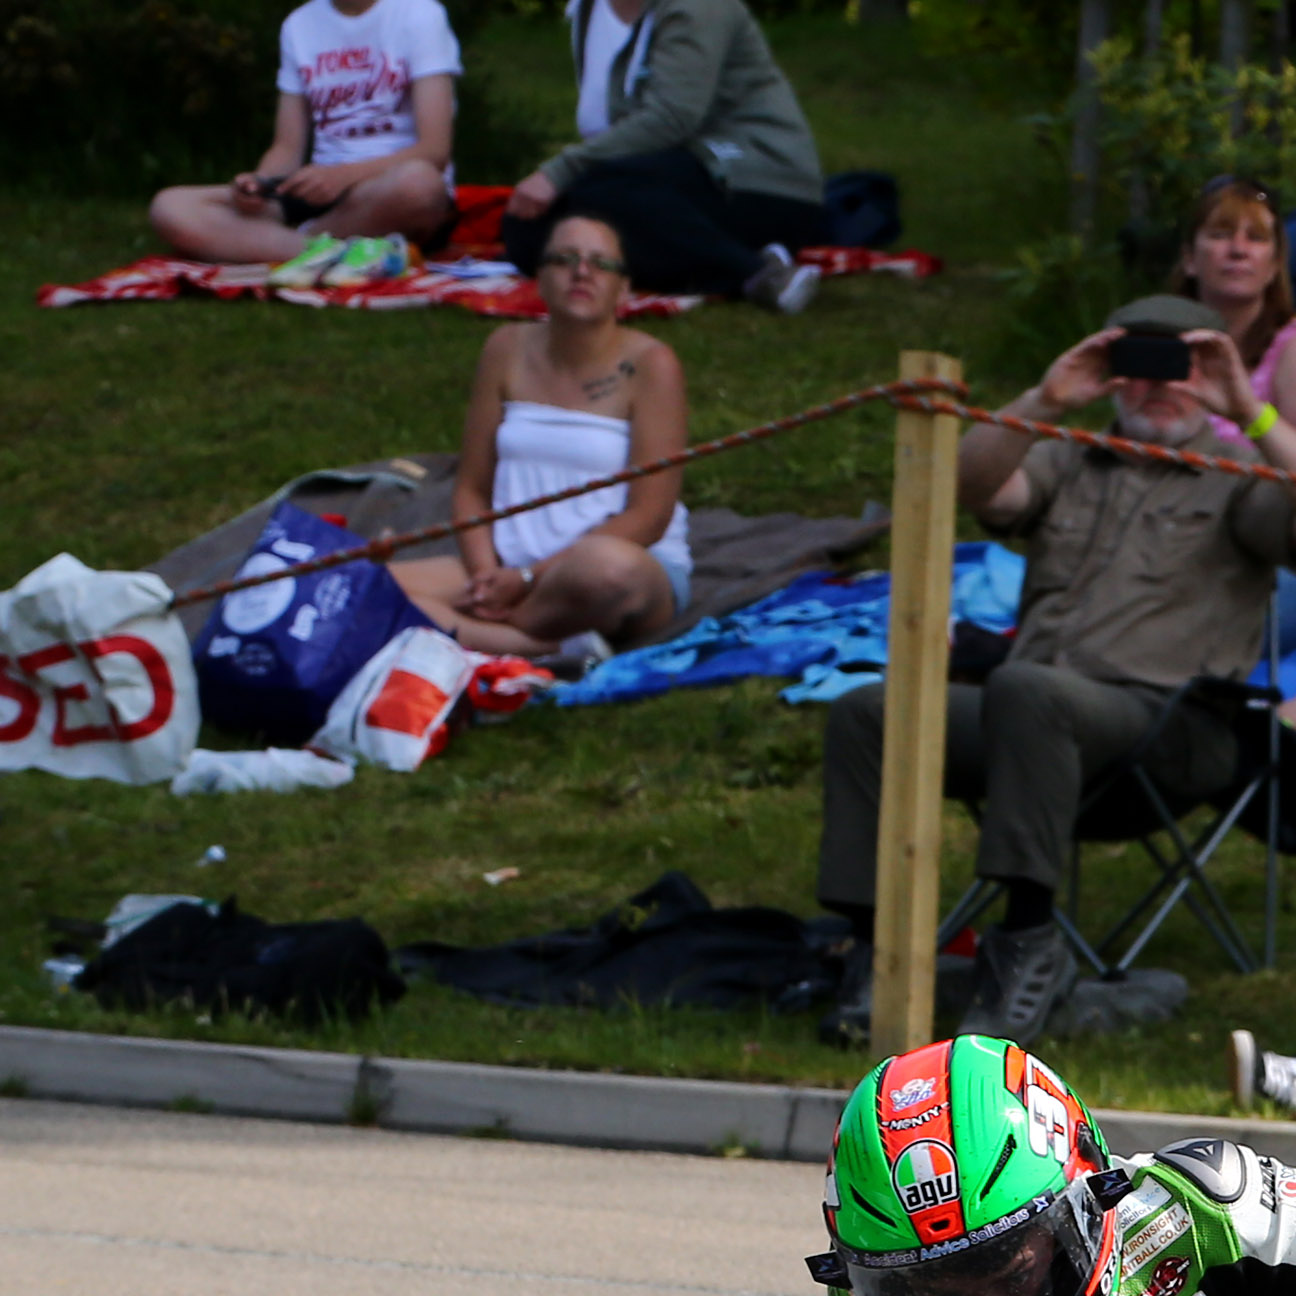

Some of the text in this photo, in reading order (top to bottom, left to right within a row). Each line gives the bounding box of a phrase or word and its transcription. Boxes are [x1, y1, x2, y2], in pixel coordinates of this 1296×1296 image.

[906, 1175, 954, 1208] agv
[921, 1237, 970, 1261] Advice
[970, 1208, 1030, 1244] Solicitors
